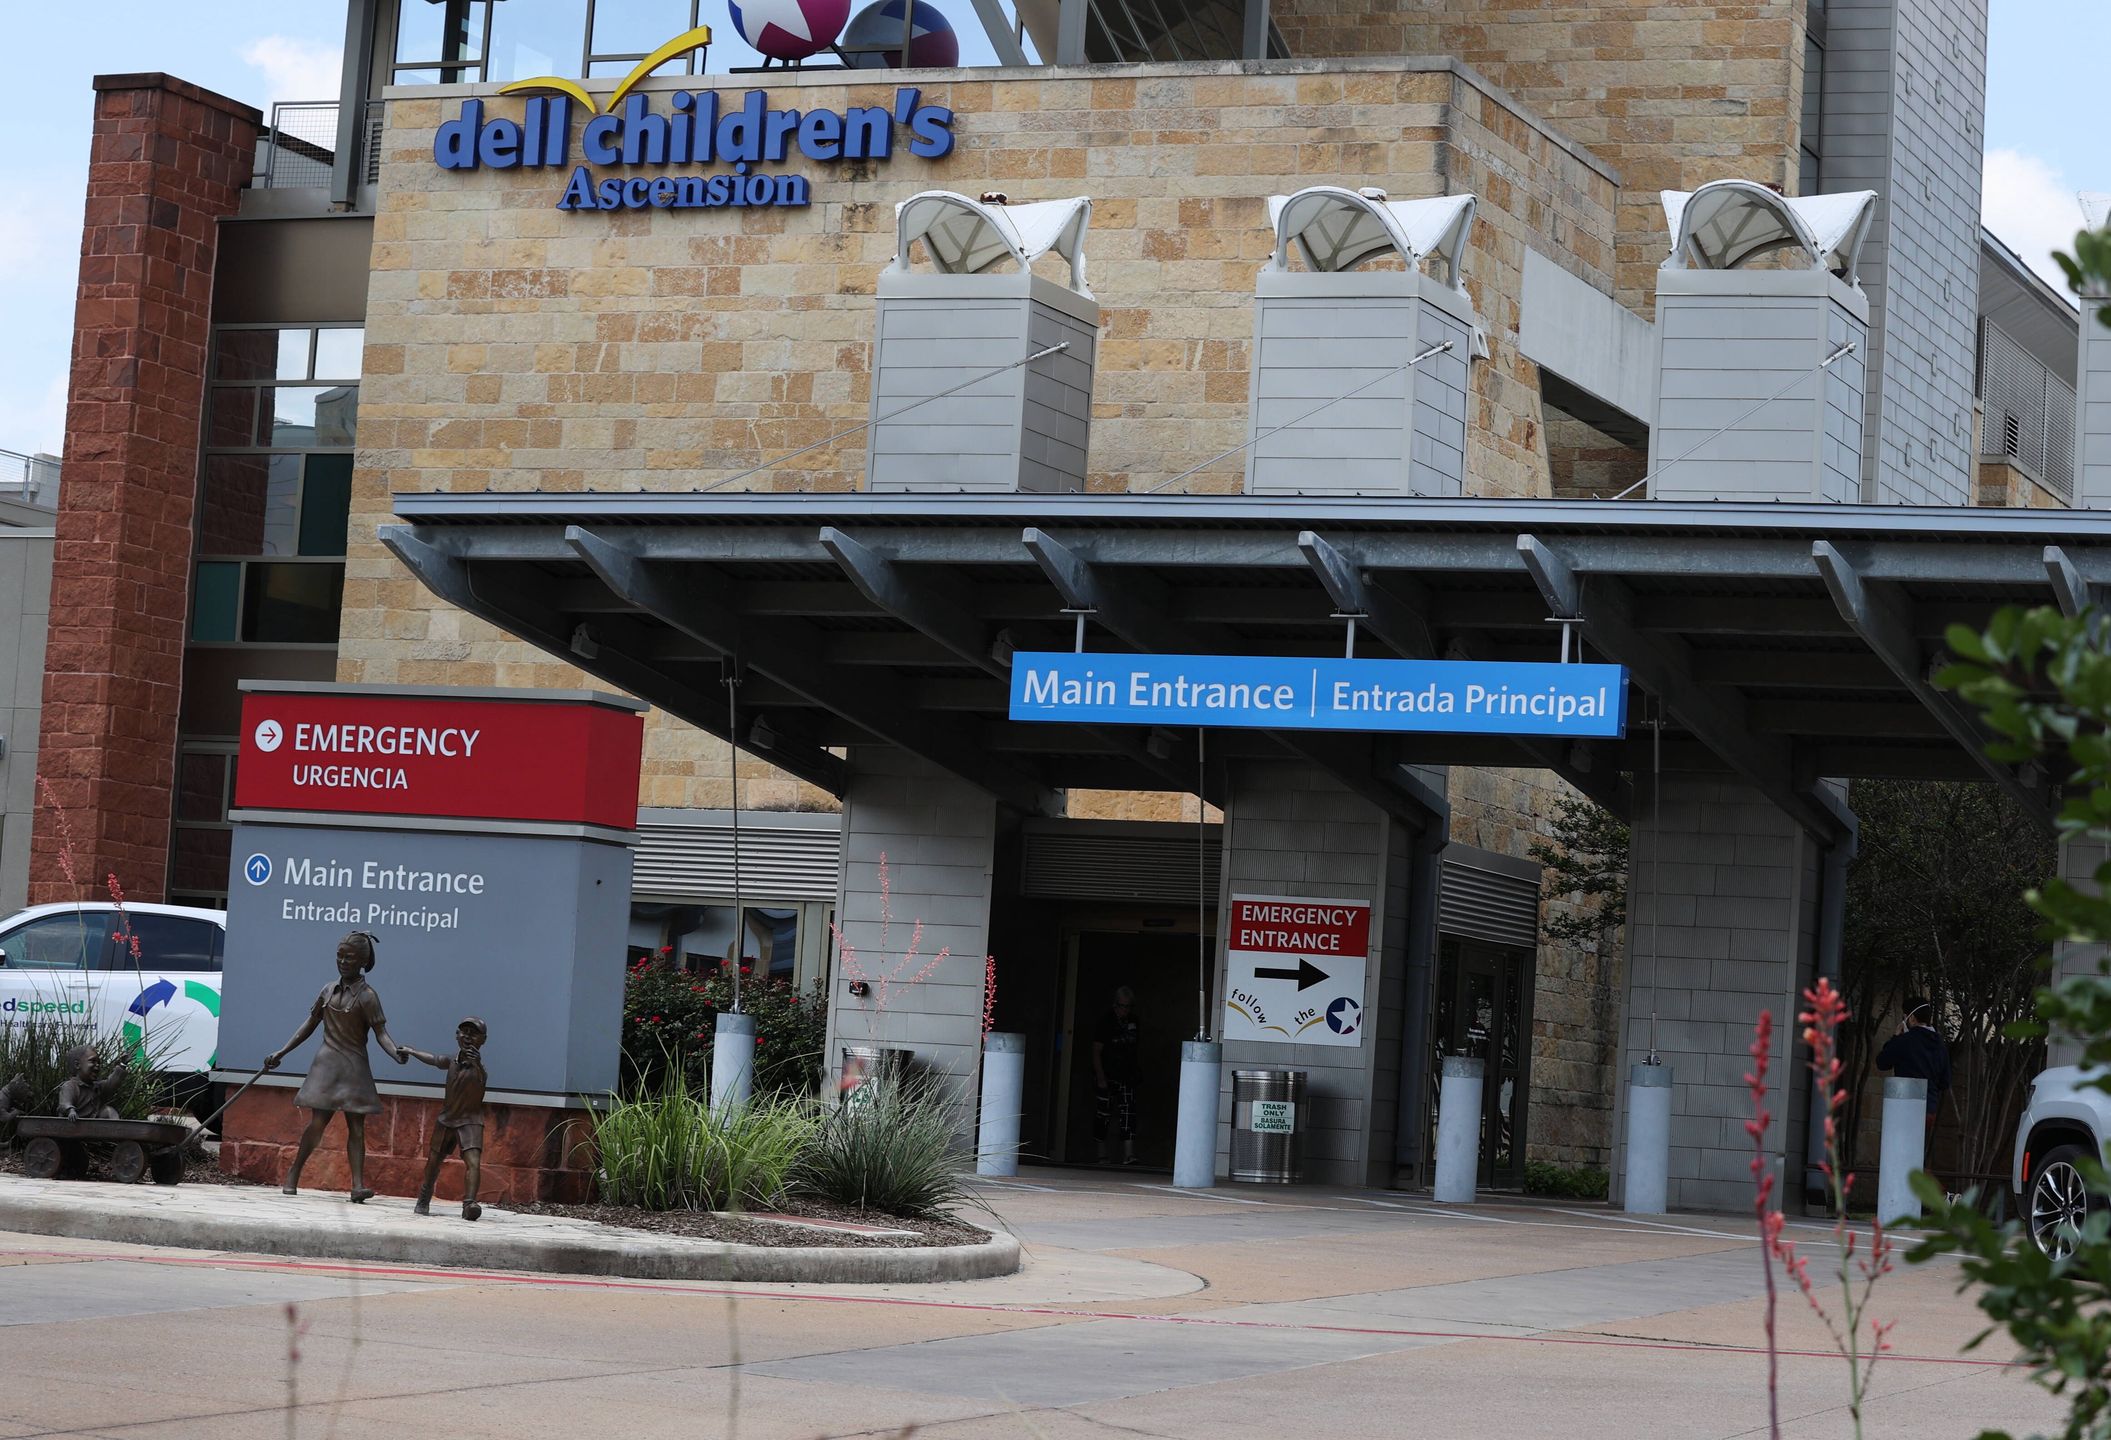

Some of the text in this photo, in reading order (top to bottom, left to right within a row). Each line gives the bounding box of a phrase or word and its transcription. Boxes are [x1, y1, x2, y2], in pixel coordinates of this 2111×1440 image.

[434, 88, 955, 169] dell children's
[556, 162, 811, 212] Ascension
[1023, 669, 1607, 723] Main Entrance Entrada Principal
[295, 723, 480, 757] EMERGENCY
[292, 764, 410, 790] URGENCIA
[283, 857, 486, 896] Main Entrance
[281, 898, 460, 933] Entrada Principal
[1241, 904, 1358, 927] EMERGENCY
[1239, 929, 1341, 951] ENTRANCE
[0, 998, 84, 1013] dspeed
[1230, 988, 1316, 1025] follow the
